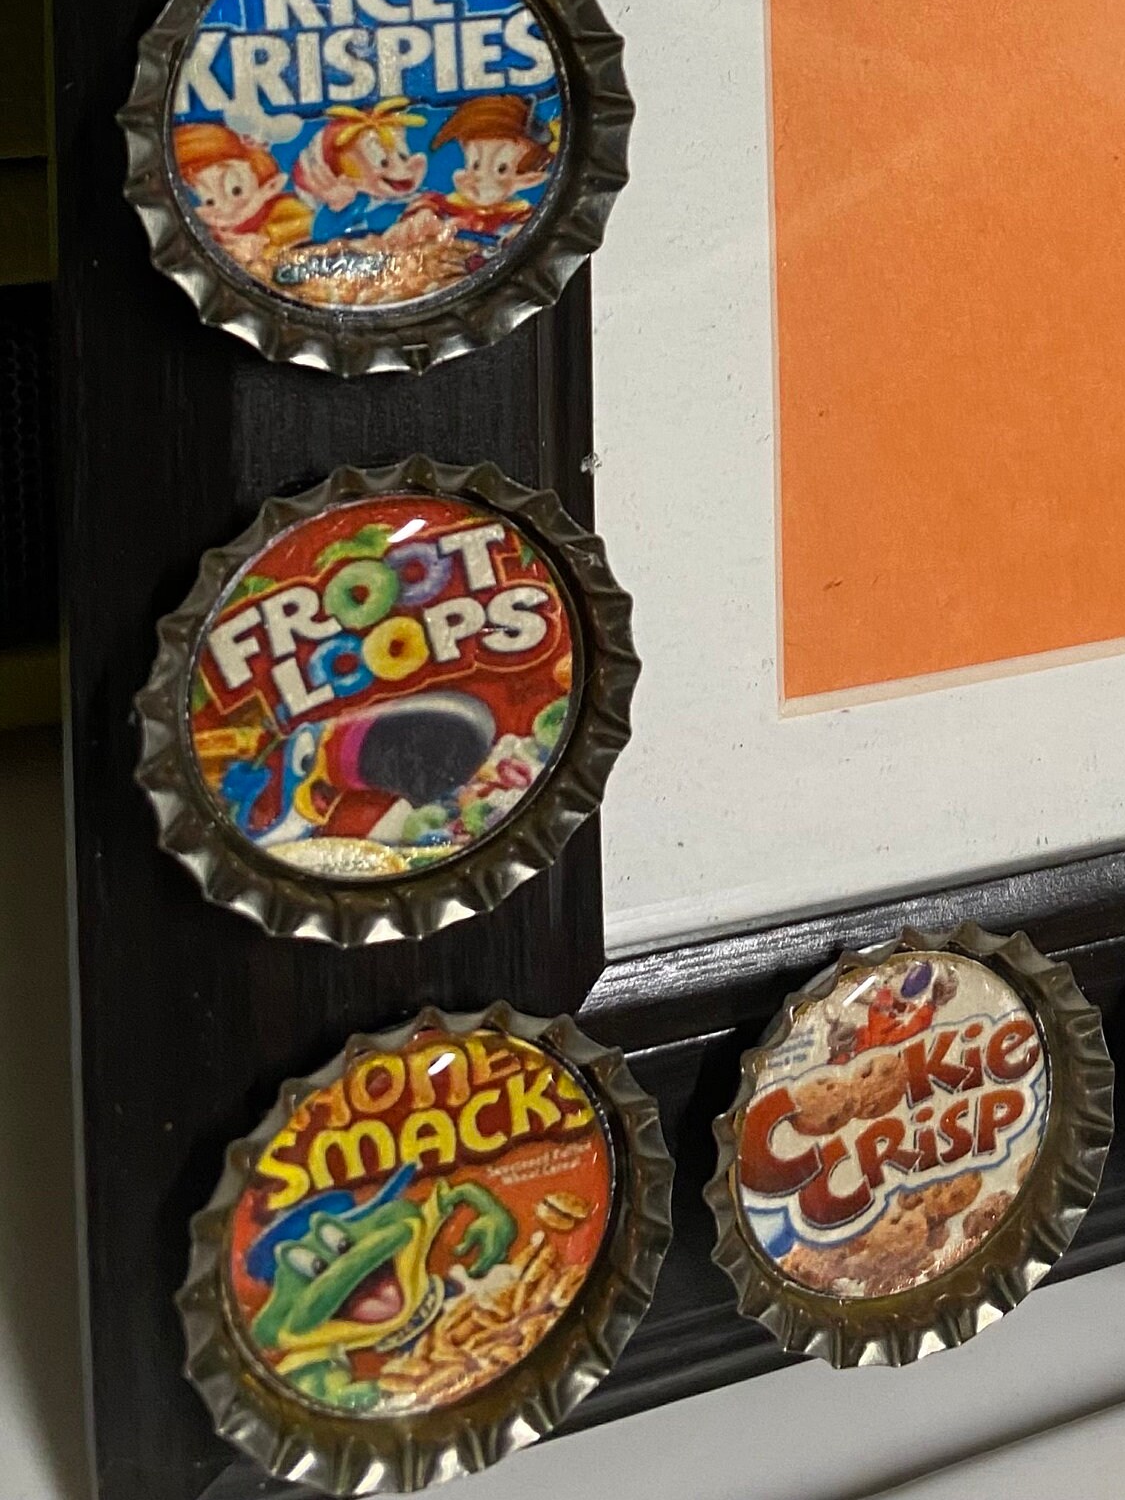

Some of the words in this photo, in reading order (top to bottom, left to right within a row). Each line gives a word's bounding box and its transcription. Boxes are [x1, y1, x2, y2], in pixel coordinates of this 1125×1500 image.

[176, 8, 555, 113] KRISPIES
[208, 523, 506, 690] FROOT
[272, 586, 550, 718] LOOPS
